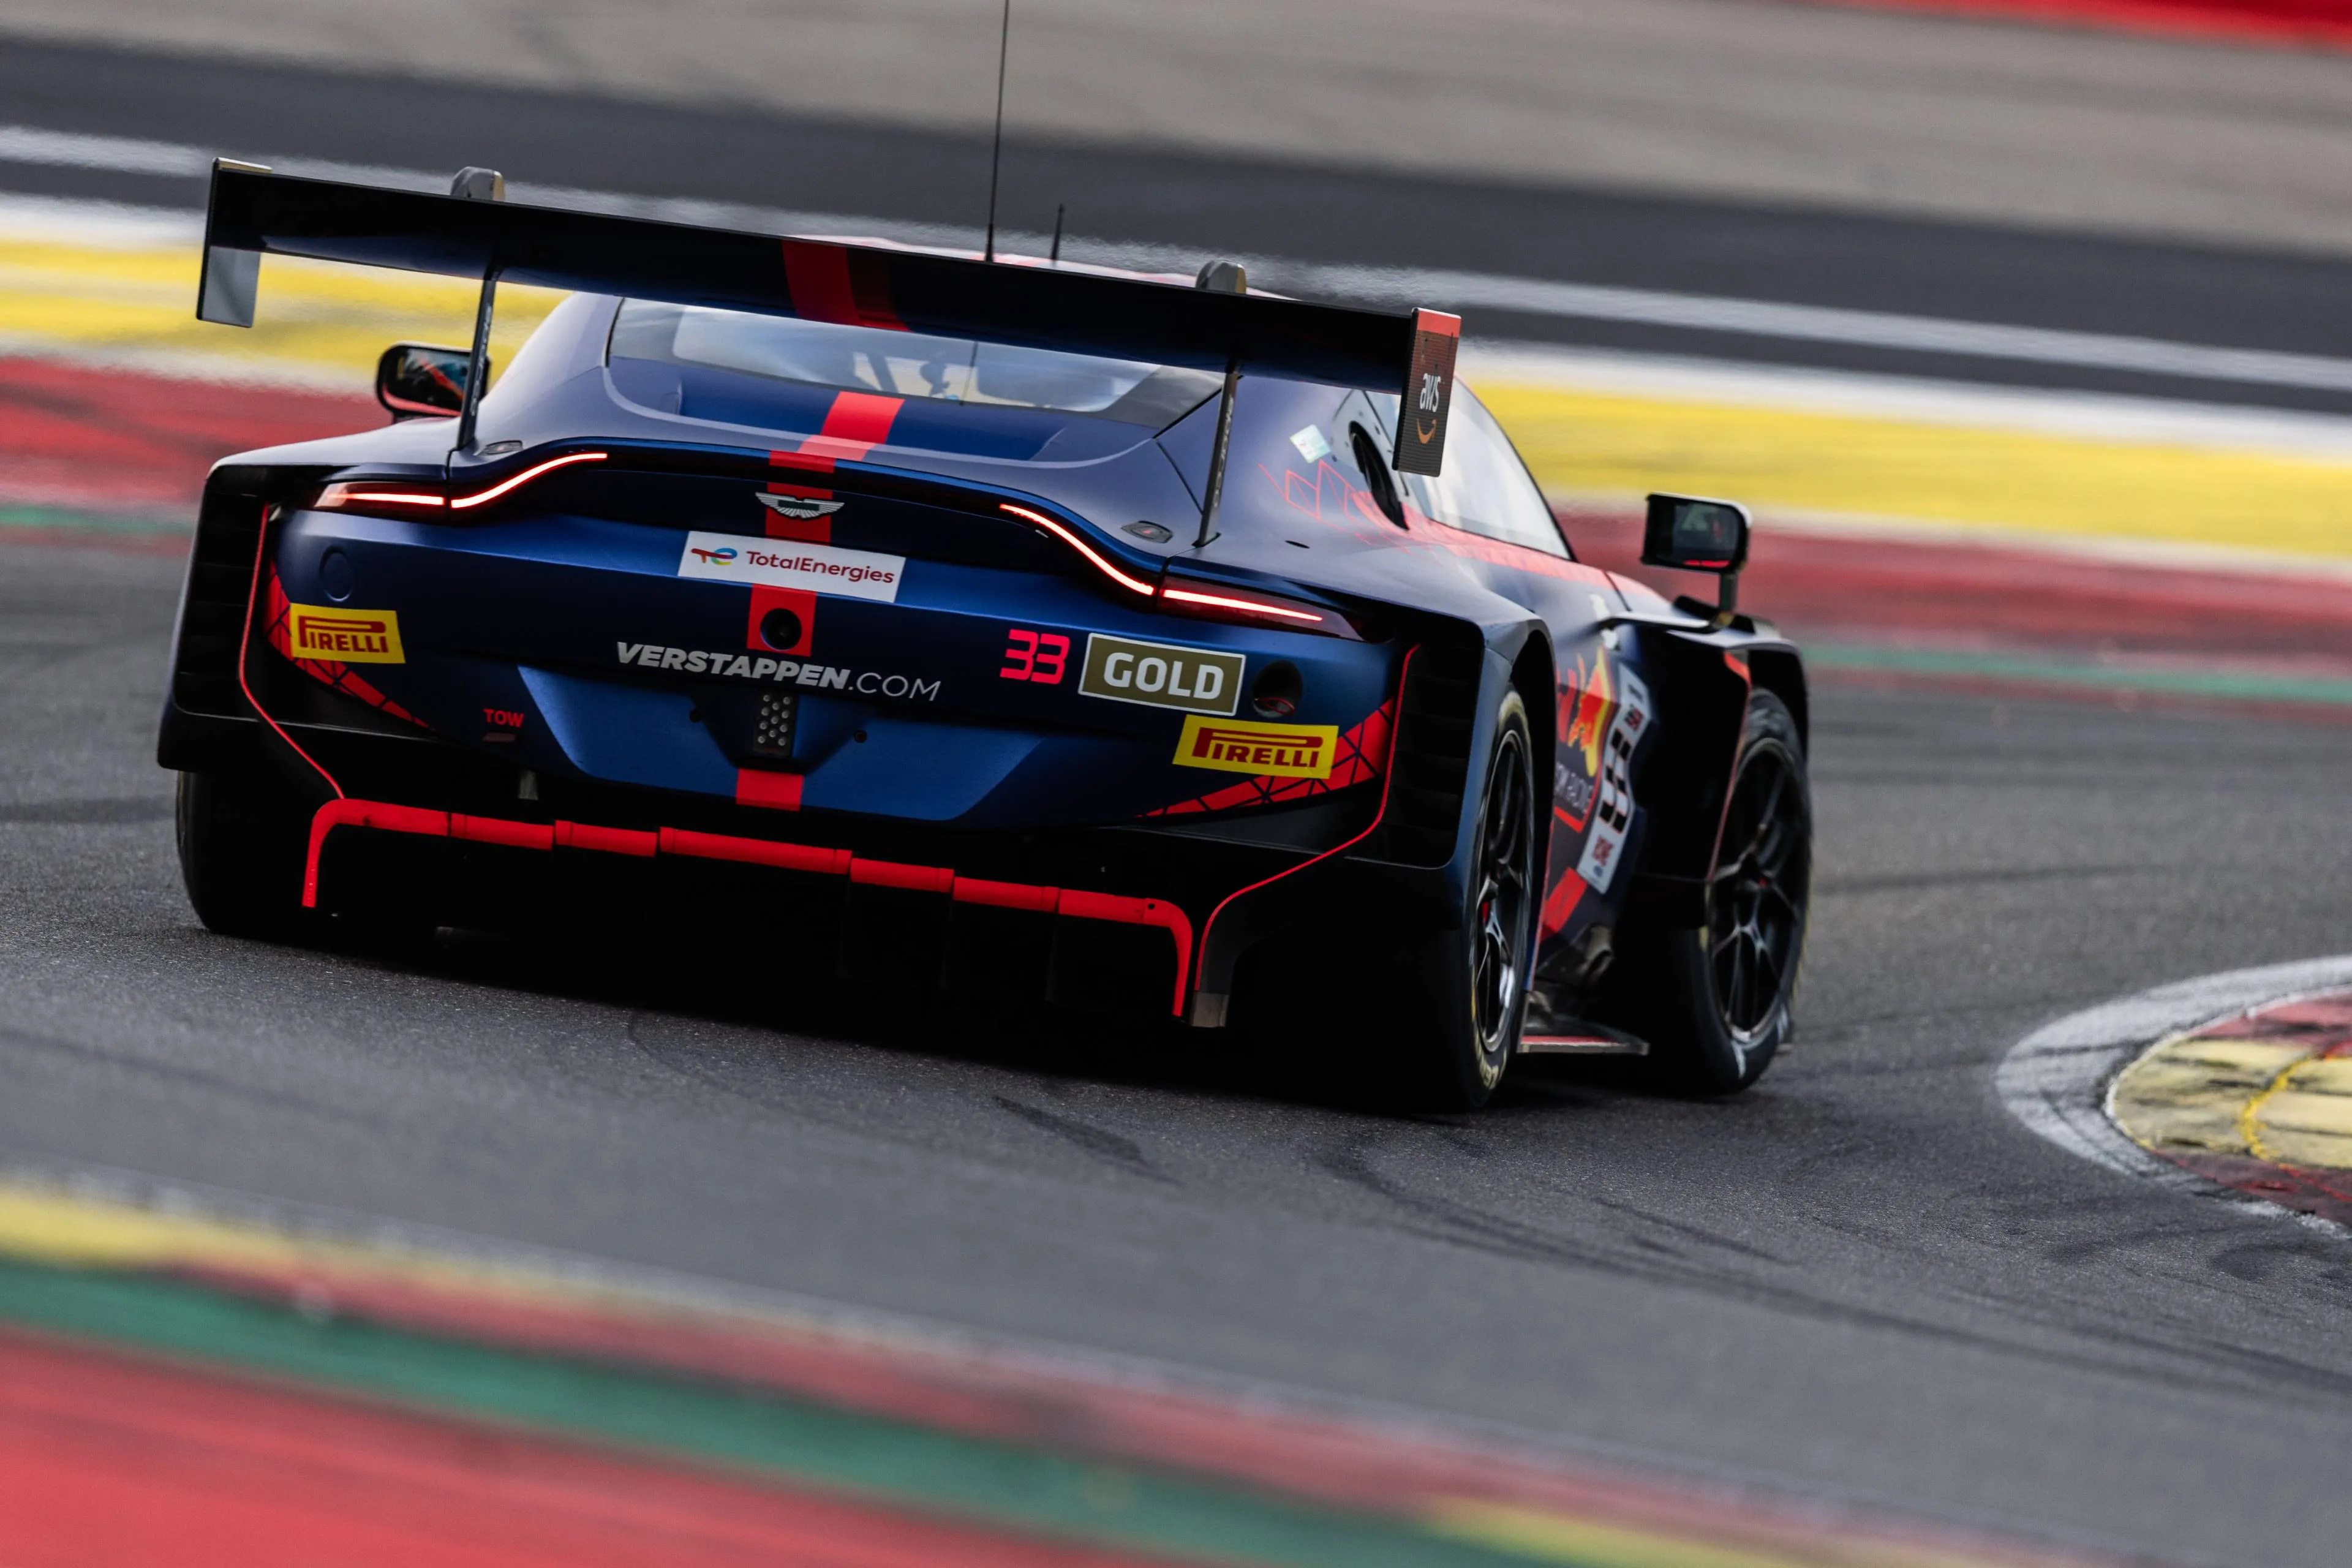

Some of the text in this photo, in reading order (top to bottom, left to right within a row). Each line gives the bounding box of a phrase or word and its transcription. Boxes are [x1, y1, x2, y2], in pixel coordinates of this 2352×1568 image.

[1419, 372, 1441, 413] aws
[746, 550, 895, 583] TotalEnergies
[297, 615, 389, 654] PIRELLI
[617, 641, 941, 702] VERSTAPPEN.COM
[999, 628, 1070, 685] 33
[1103, 652, 1224, 700] GOLD
[483, 708, 524, 728] TOW
[1191, 726, 1323, 769] PIRELLI
